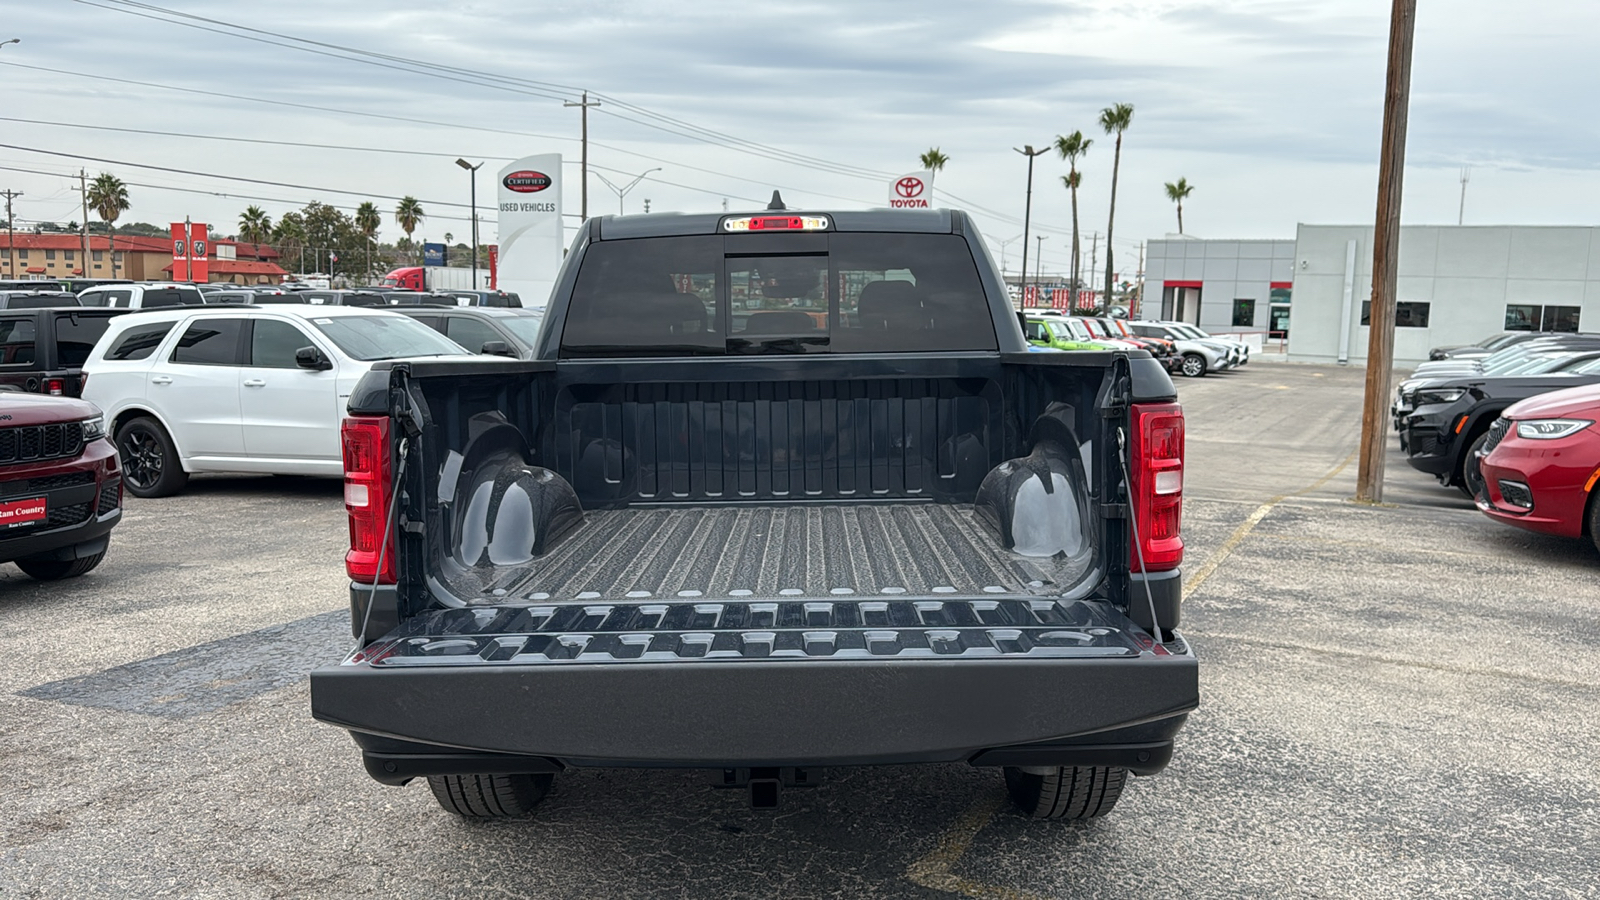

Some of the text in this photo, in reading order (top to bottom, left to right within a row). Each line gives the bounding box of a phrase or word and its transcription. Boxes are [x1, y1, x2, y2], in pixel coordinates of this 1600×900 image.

[499, 203, 556, 212] USED VEHICLES
[890, 199, 928, 208] TOYOTA
[15, 506, 46, 516] Country
